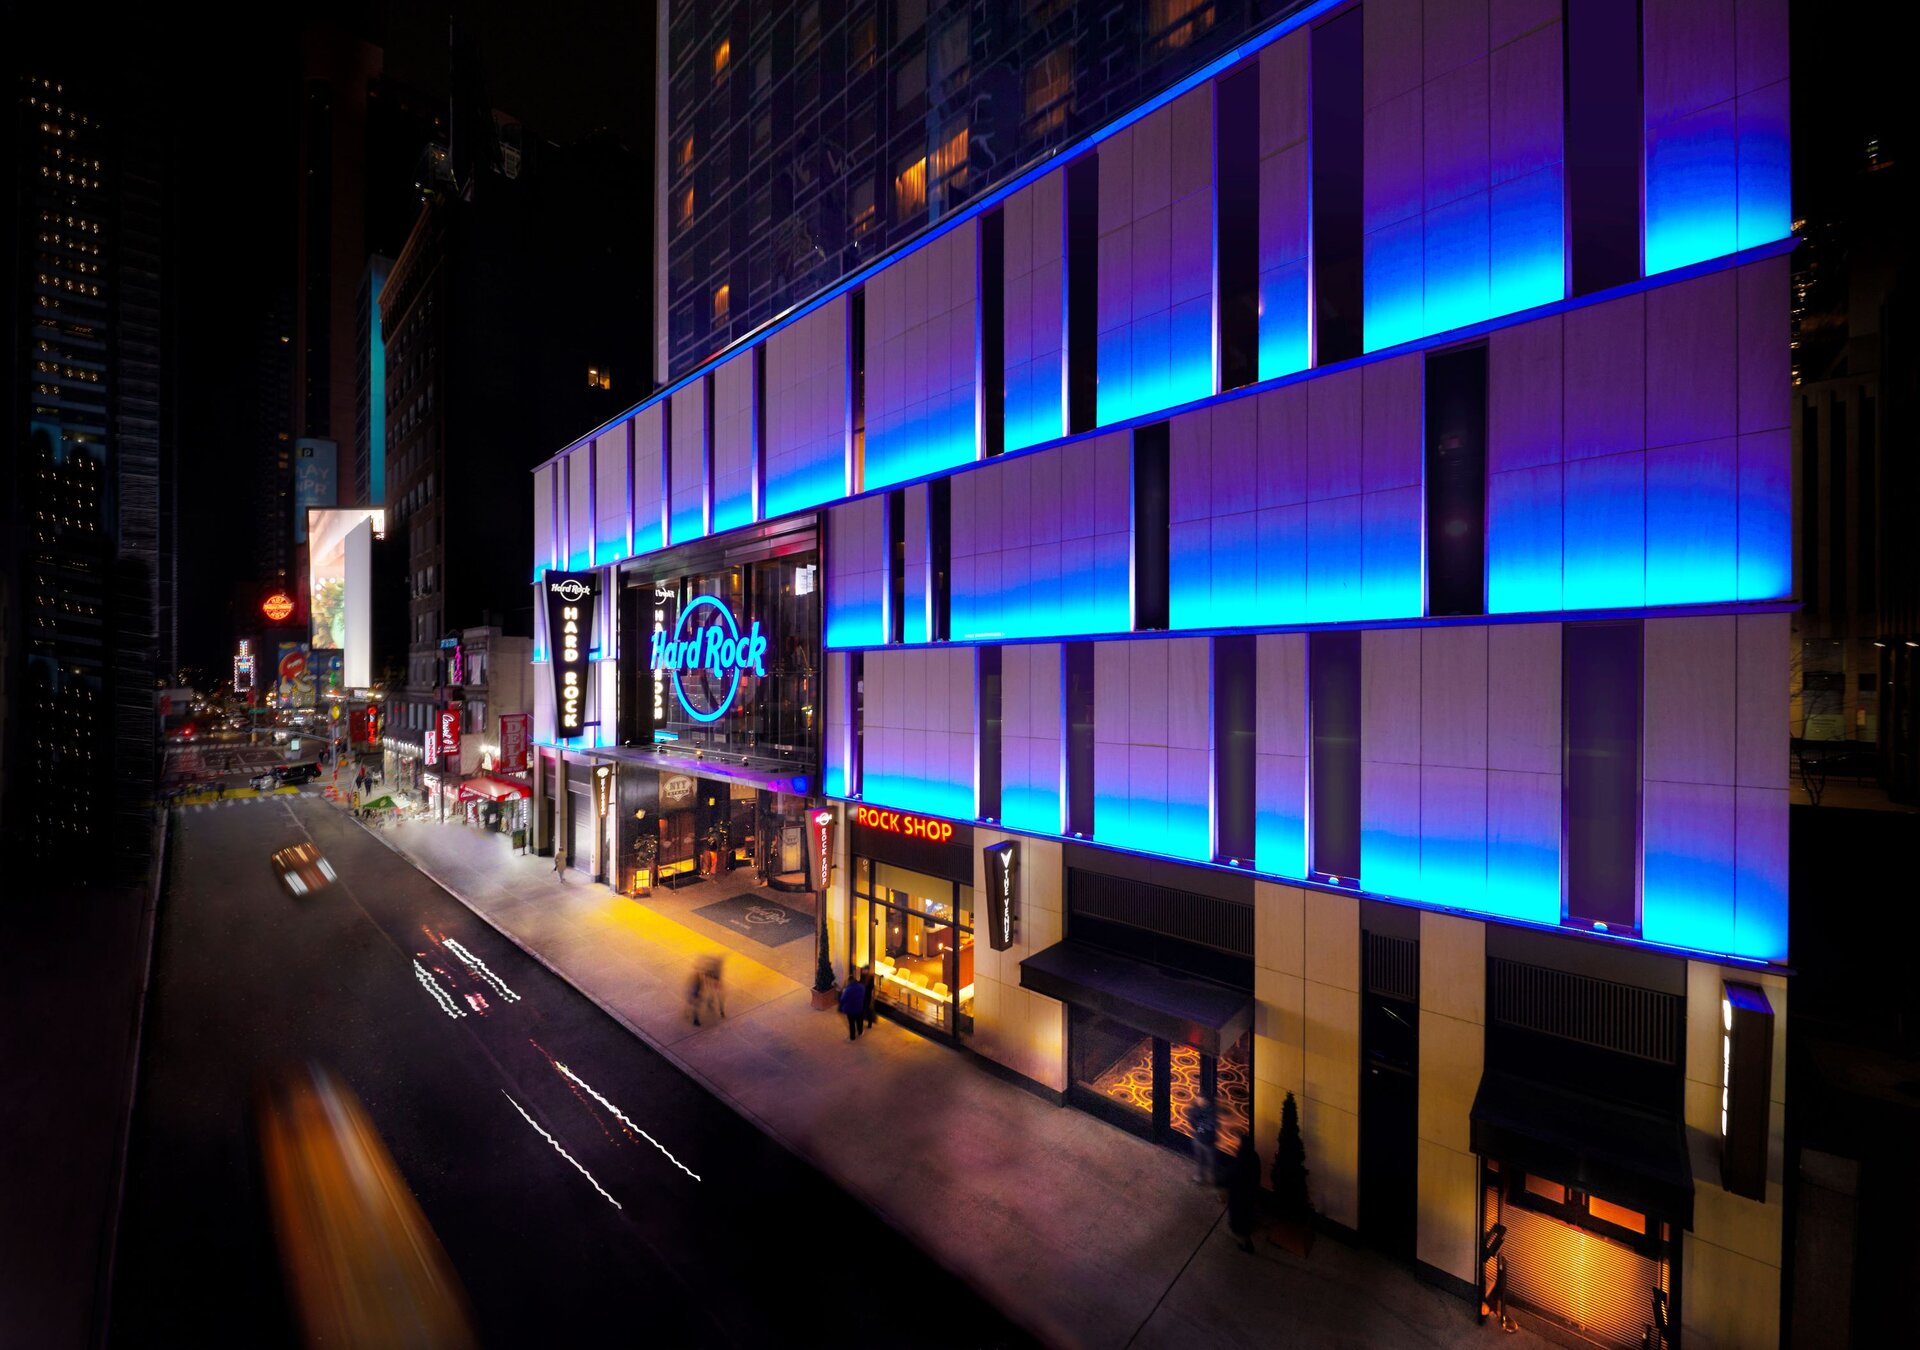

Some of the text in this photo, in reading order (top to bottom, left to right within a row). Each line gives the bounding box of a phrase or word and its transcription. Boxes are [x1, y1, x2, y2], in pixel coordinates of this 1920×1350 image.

[551, 583, 591, 596] Hard Rock
[563, 606, 580, 727] HARD ROCK
[650, 621, 768, 679] Hard Rock
[428, 731, 437, 764] PIZZA
[507, 722, 521, 767] DELI
[821, 827, 829, 856] ROCK
[857, 807, 900, 832] ROCK
[903, 816, 953, 842] SHOP
[821, 857, 829, 886] SHOP
